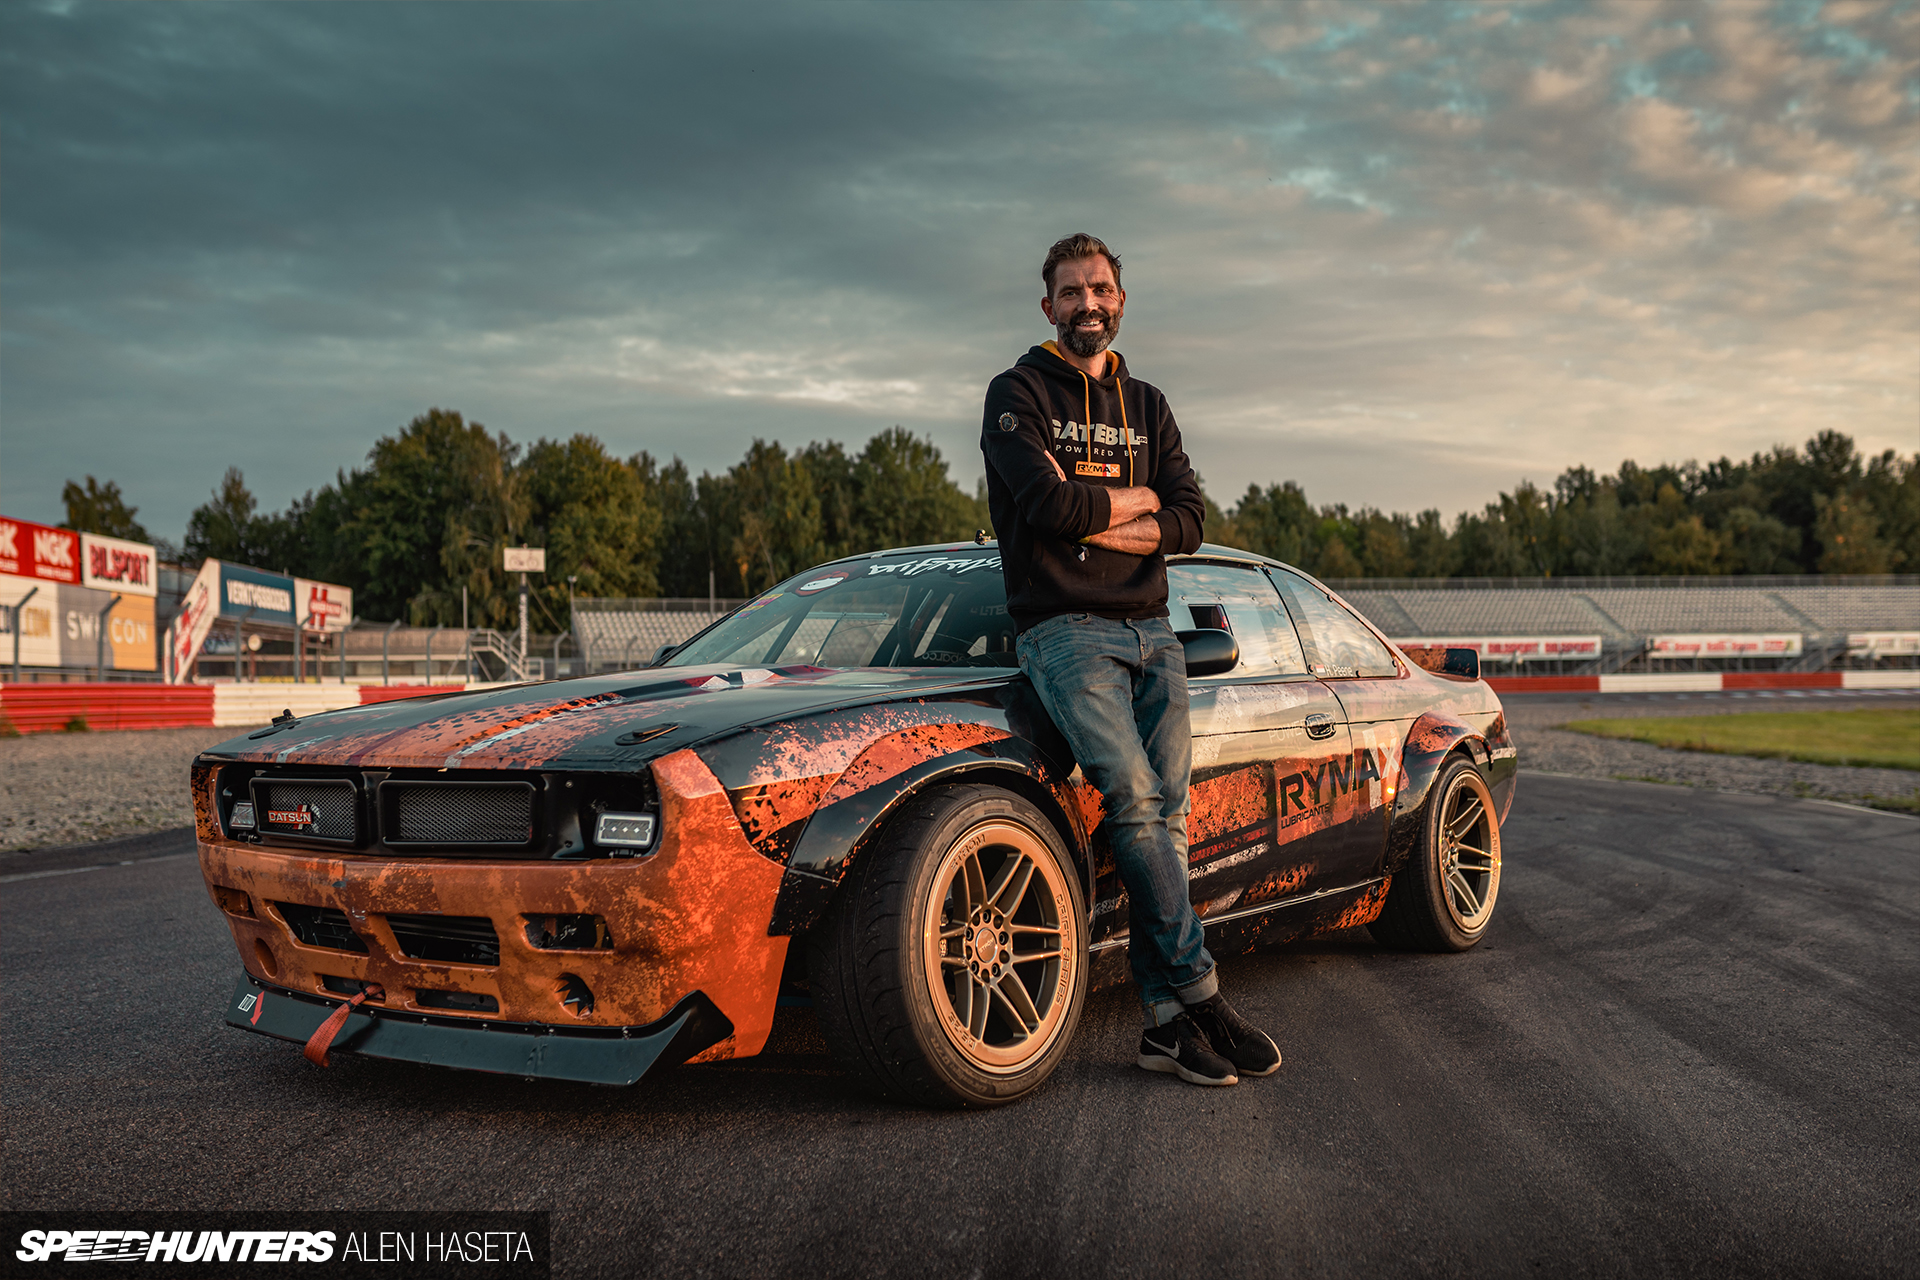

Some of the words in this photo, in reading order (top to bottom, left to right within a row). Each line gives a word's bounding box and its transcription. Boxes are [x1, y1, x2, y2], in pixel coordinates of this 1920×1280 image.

[1077, 463, 1119, 474] RYMAX
[33, 529, 74, 568] NGK
[90, 544, 149, 585] BILSPORT
[1280, 737, 1400, 818] RYMAX
[268, 812, 312, 823] DATSUN
[1280, 802, 1330, 830] LUBRICANTS
[1056, 893, 1071, 942] DRIFT
[1056, 947, 1071, 1007] SERIES
